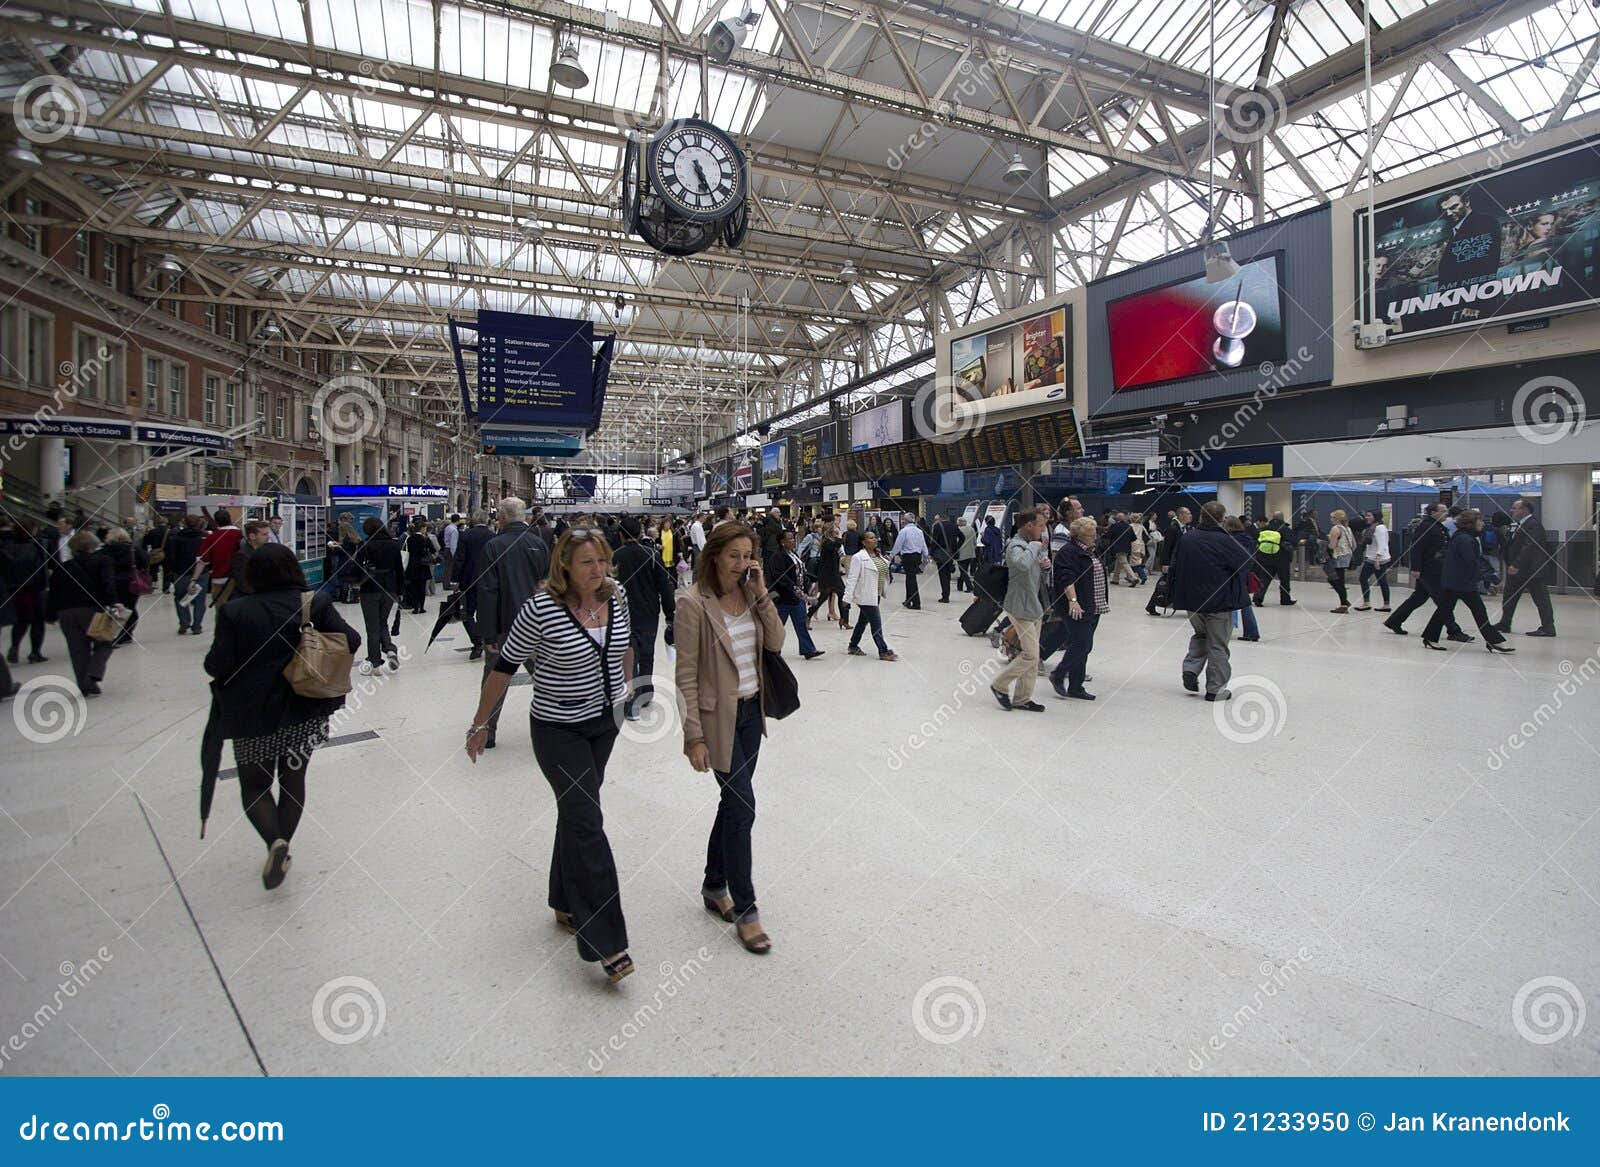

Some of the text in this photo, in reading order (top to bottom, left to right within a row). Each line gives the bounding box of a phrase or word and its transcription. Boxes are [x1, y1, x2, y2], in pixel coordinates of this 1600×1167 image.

[1387, 266, 1563, 320] UNKNOWN
[504, 368, 539, 376] Underground
[13, 422, 121, 436] Werloo East Station
[160, 432, 192, 441] Waterloo
[1171, 456, 1184, 468] 12
[389, 486, 408, 495] Rail
